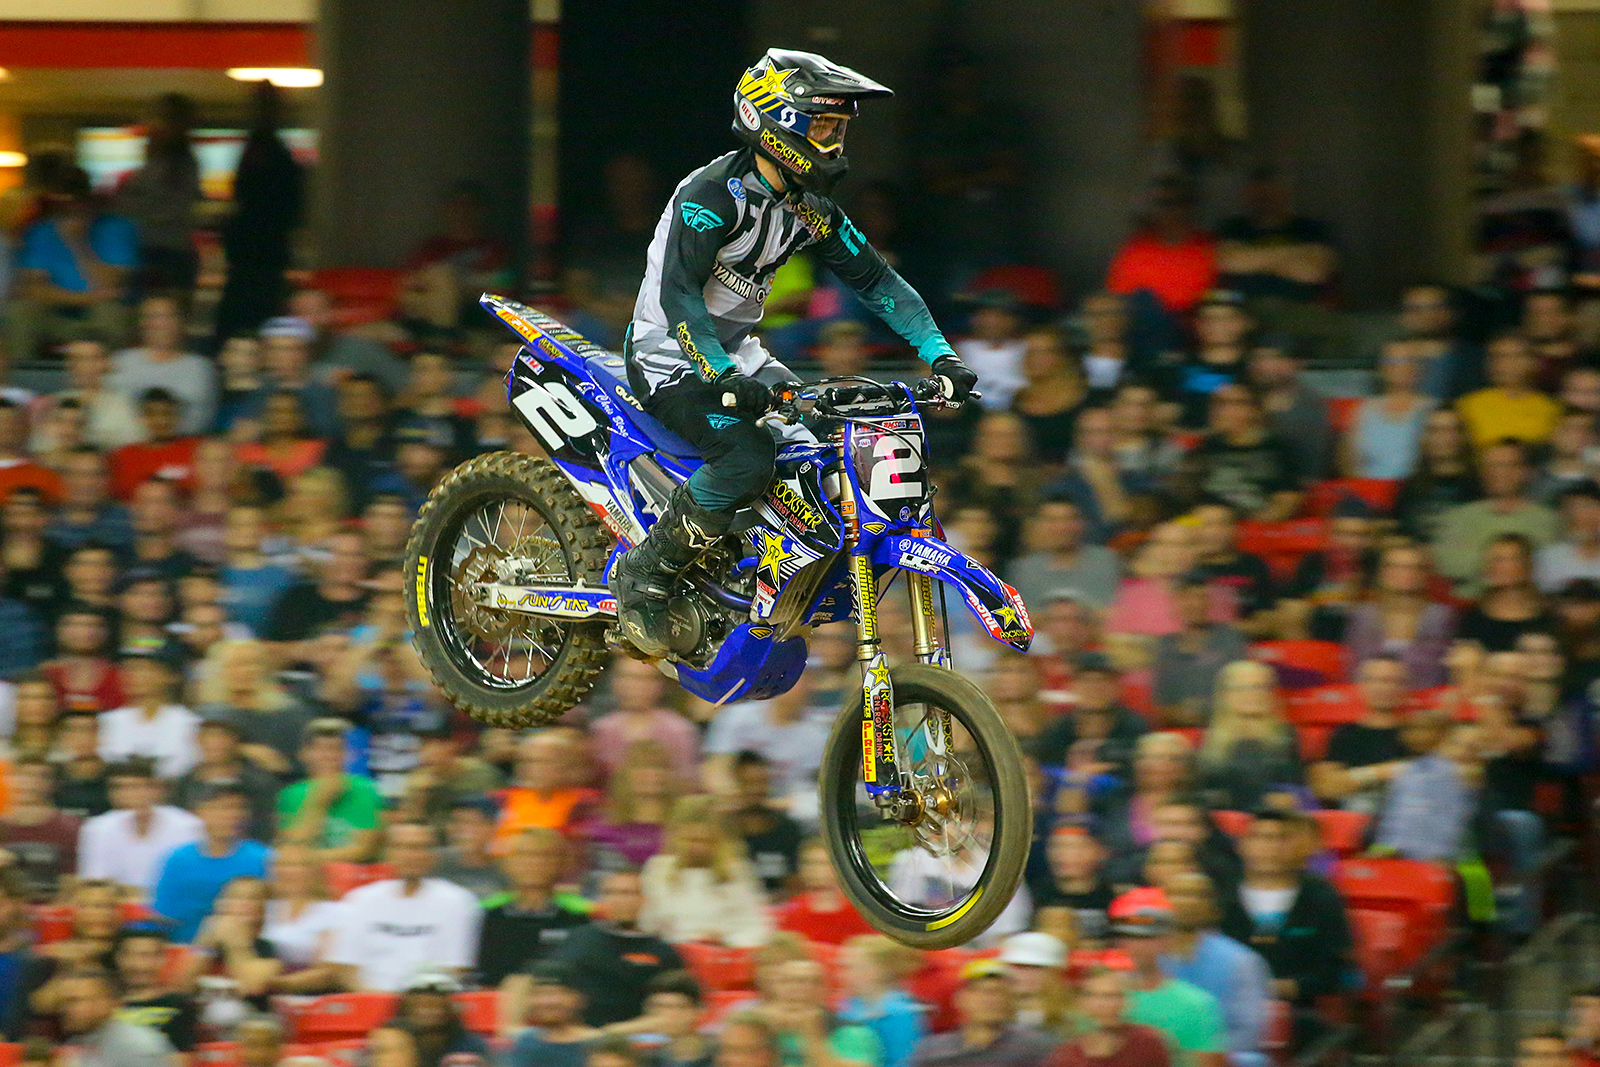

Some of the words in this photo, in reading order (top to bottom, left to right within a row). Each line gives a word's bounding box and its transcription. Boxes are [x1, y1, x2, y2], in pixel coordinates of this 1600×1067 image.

[741, 103, 755, 126] BELL
[714, 265, 752, 298] YAMAHA
[512, 382, 597, 451] 2
[869, 434, 921, 500] 2
[605, 499, 632, 534] YAMAHA
[788, 512, 808, 532] DRINK
[911, 542, 952, 567] YAMAHA
[415, 555, 430, 627] PIRELLI
[969, 593, 999, 631] MOTUL
[874, 695, 882, 729] ENERGY
[864, 722, 872, 780] PIRELLI
[875, 731, 883, 757] DRINK
